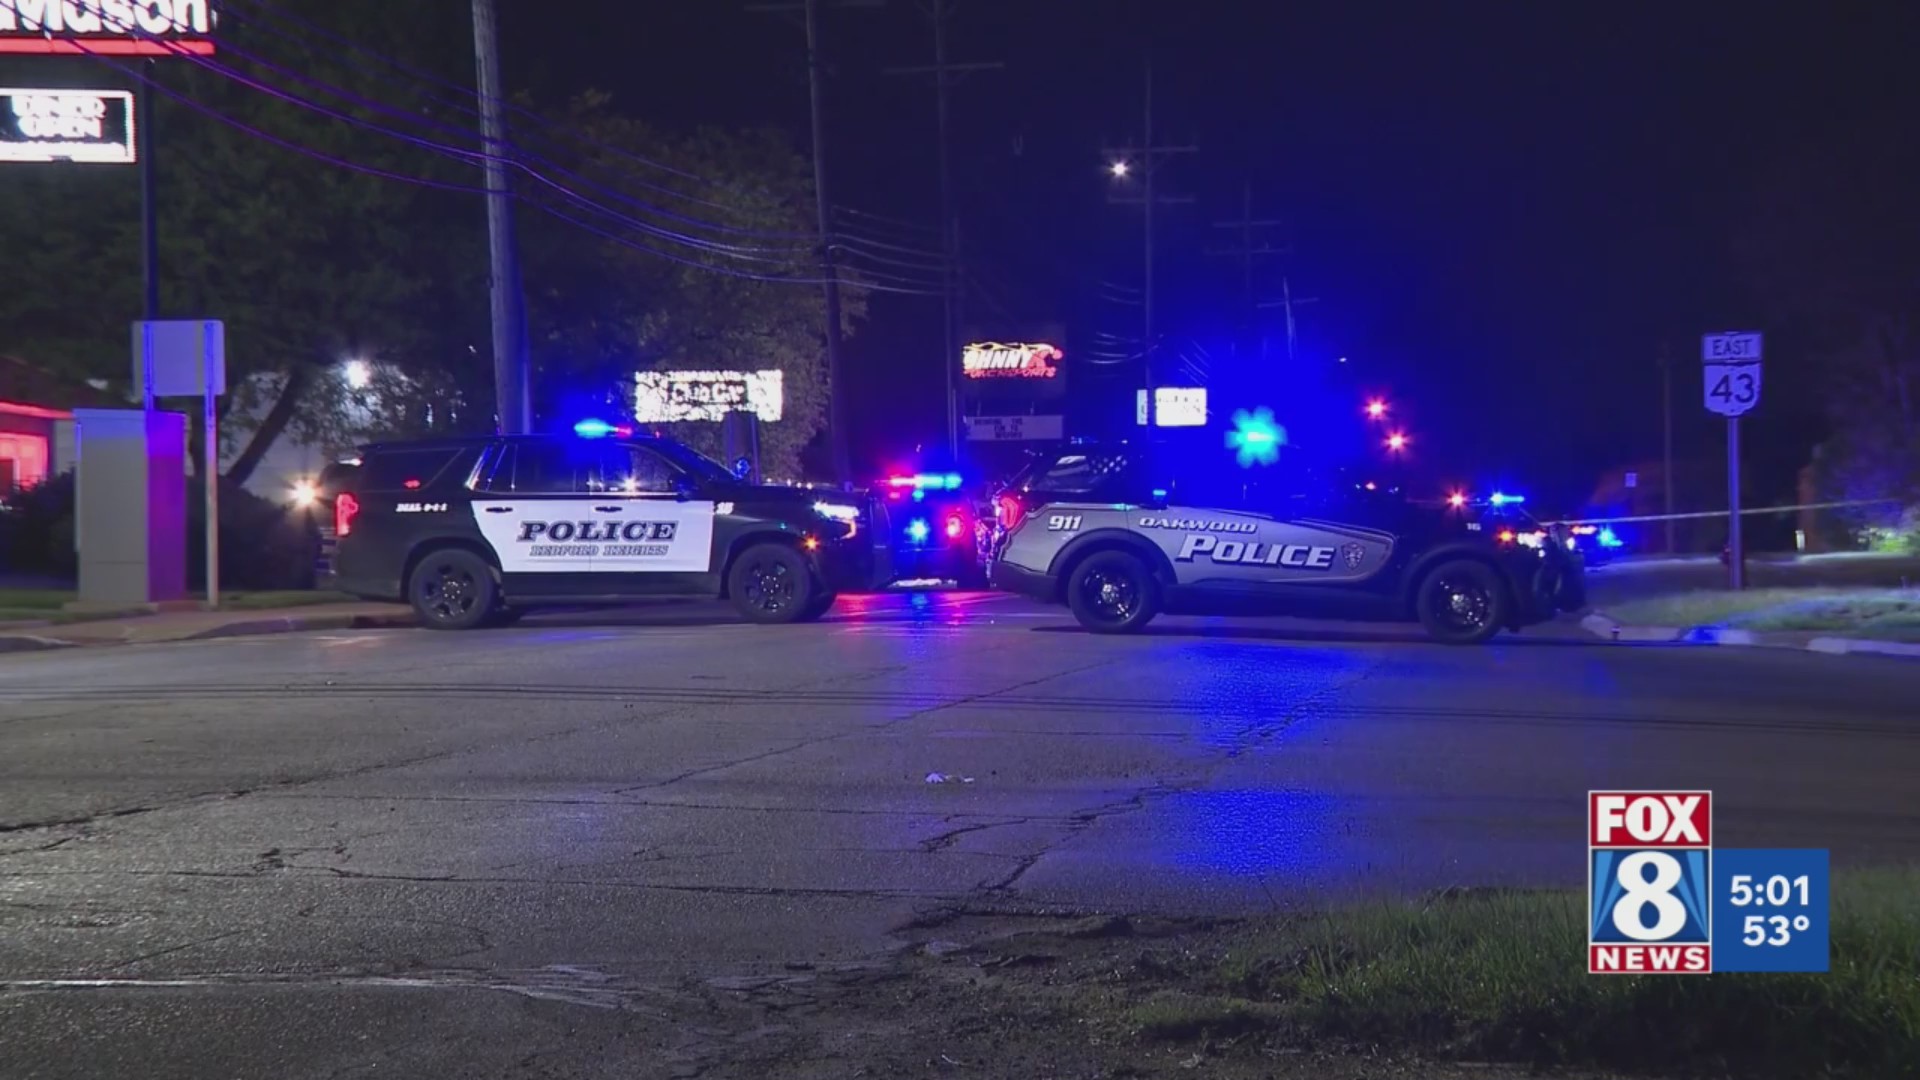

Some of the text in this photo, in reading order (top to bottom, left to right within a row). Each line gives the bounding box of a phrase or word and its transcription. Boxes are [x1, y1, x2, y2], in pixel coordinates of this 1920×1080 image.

[1712, 339, 1752, 356] EAST
[1710, 373, 1755, 403] 43
[516, 520, 679, 543] POLICE
[1048, 515, 1082, 531] 911
[1139, 517, 1258, 534] OAKWOOD
[603, 545, 669, 556] HEIGHTS
[1176, 534, 1335, 569] POLICE
